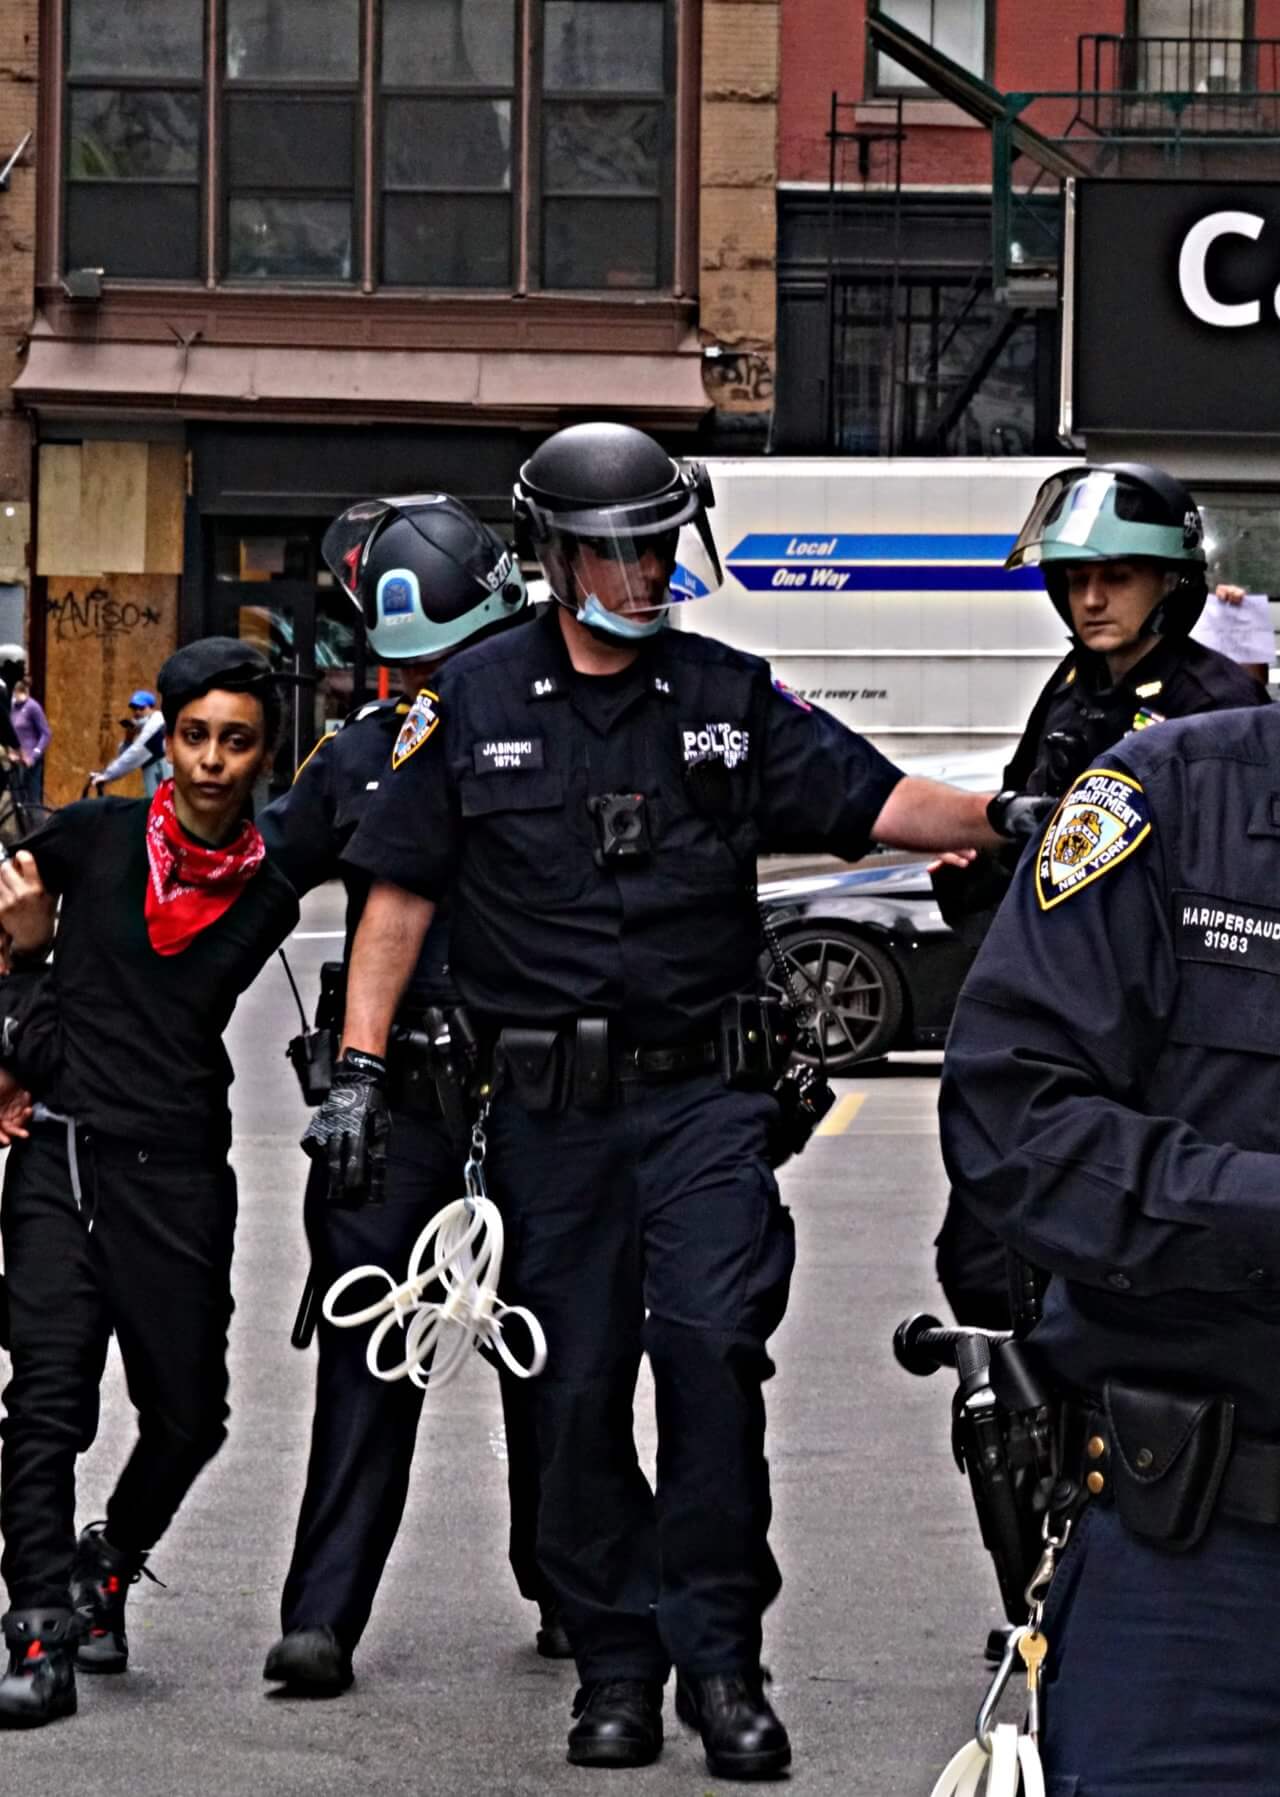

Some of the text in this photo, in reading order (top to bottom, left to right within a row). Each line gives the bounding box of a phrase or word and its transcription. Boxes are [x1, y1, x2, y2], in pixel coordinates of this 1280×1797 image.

[785, 538, 838, 556] Local
[771, 567, 851, 590] One Way
[824, 689, 859, 702] every
[682, 730, 750, 752] POLICE
[1084, 776, 1133, 801] POLICE
[1069, 789, 1142, 828] DEPARTMENT
[1058, 835, 1129, 892] NEW YORK
[1204, 930, 1249, 953] 31983
